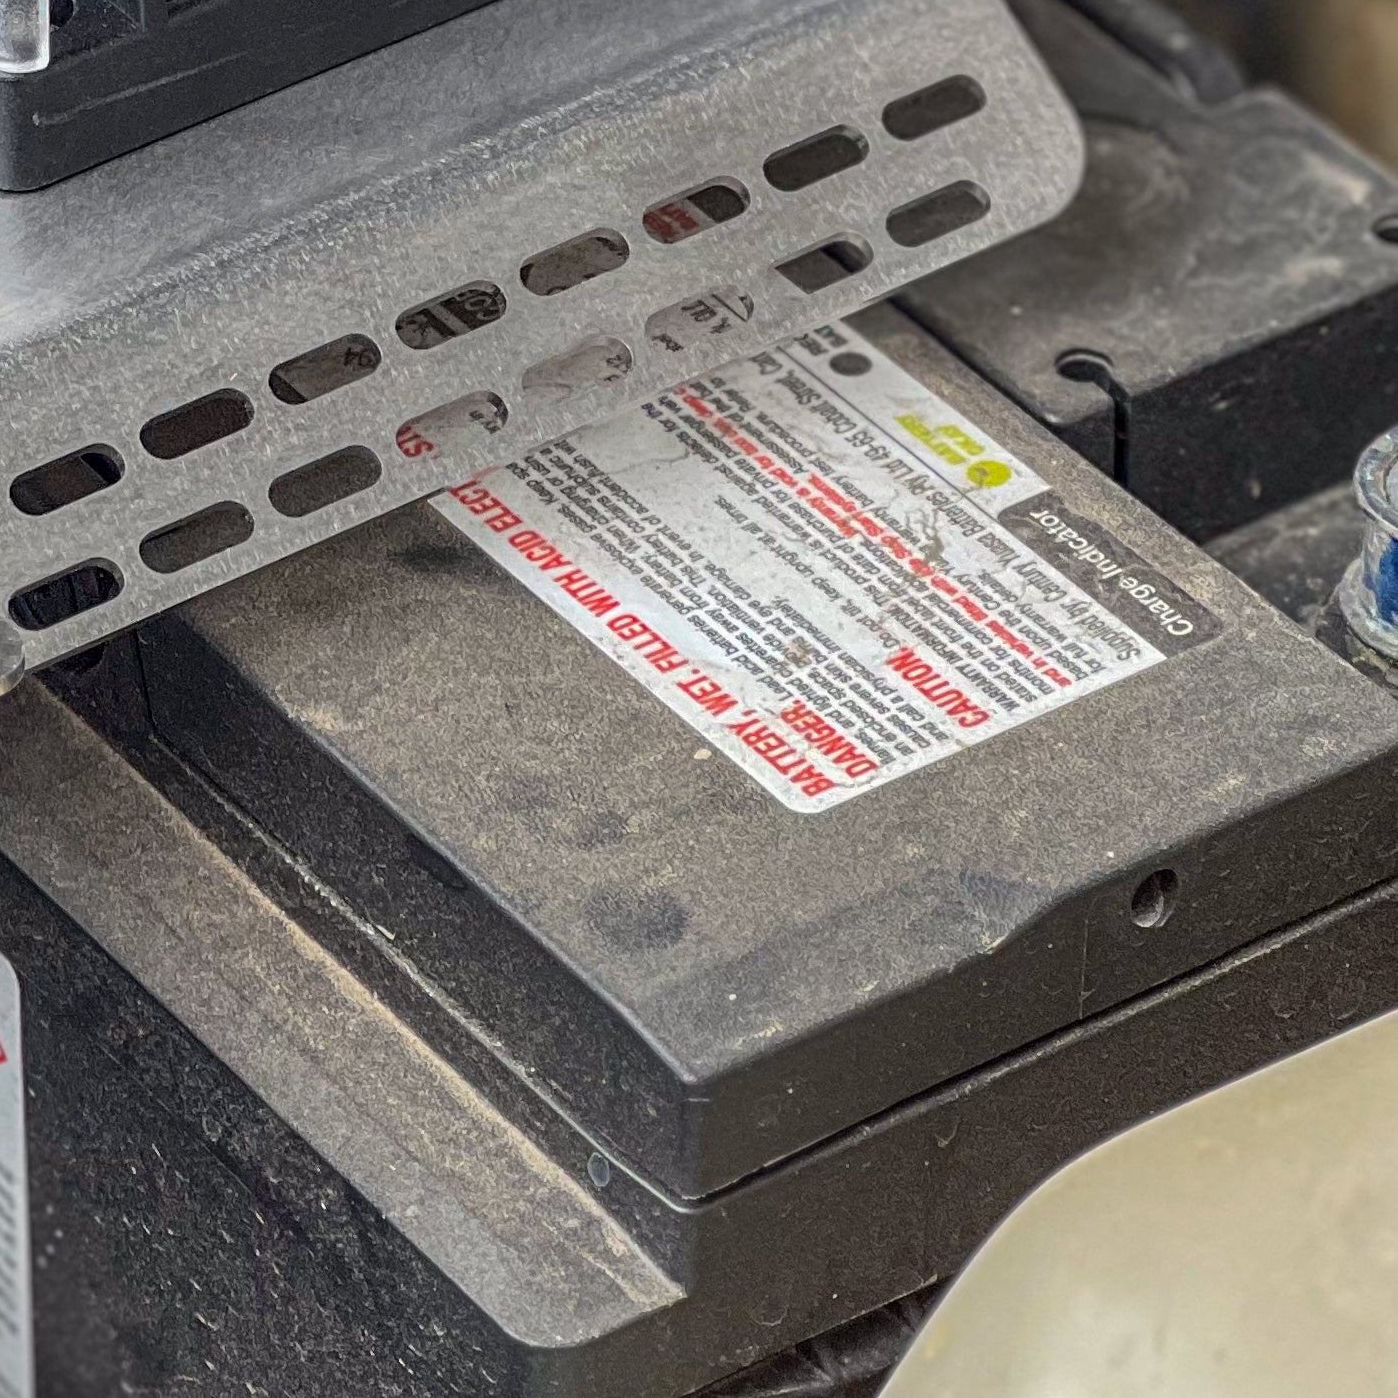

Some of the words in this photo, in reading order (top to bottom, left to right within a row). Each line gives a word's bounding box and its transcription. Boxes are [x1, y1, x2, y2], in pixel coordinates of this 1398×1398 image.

[709, 375, 728, 389] to
[772, 368, 822, 406] Street,
[640, 401, 664, 419] the
[709, 395, 734, 414] the
[722, 386, 757, 413] Refer
[658, 416, 681, 433] for
[807, 400, 858, 435] Cobalt
[675, 429, 721, 466] defects
[679, 412, 742, 458] passenger
[740, 422, 809, 475] Assessment
[844, 429, 894, 463] 49-65
[544, 474, 564, 488] or
[546, 455, 601, 497] sulphuric
[711, 462, 760, 497] against
[733, 456, 779, 488] private
[767, 466, 801, 488] void
[805, 456, 837, 477] test
[880, 459, 914, 480] Ltd
[525, 476, 560, 505] Keep
[558, 485, 610, 526] charging
[594, 475, 650, 515] accident
[770, 486, 793, 503] for
[831, 473, 875, 508] battery
[595, 495, 646, 534] contains
[640, 513, 663, 526] of
[713, 493, 750, 524] times.
[751, 495, 813, 540] warranted
[786, 500, 846, 543] purchase
[806, 494, 861, 538] Warranty
[869, 504, 923, 545] warranty
[924, 490, 985, 537] Batteries
[604, 524, 642, 553] When
[653, 524, 694, 552] event
[740, 521, 764, 535] all
[754, 532, 777, 545] at
[1029, 505, 1124, 579] Indicator
[505, 528, 571, 574] ACID
[589, 532, 646, 575] explosive
[639, 530, 685, 567] battery
[767, 543, 816, 577] upright
[808, 538, 826, 551] is
[833, 541, 857, 554] of
[975, 531, 1022, 566] Yuasa
[678, 564, 708, 587] This
[816, 548, 871, 585] product
[850, 552, 882, 576] date
[552, 568, 622, 616] WITH
[639, 573, 696, 615] generate
[810, 574, 844, 601] keep
[862, 583, 892, 606] This
[926, 574, 960, 596] with
[953, 571, 1003, 611] Century
[976, 567, 1021, 604] details.
[1012, 559, 1068, 603] Century
[678, 585, 711, 610] from
[746, 598, 775, 618] eye
[899, 595, 937, 621] label
[1116, 575, 1196, 637] Charge
[704, 606, 740, 633] away
[765, 616, 796, 636] and
[770, 594, 842, 655] immediately.
[854, 614, 883, 632] not
[921, 591, 995, 645] commercial
[927, 617, 964, 643] front
[997, 608, 1022, 627] the
[1014, 600, 1070, 643] warranty
[604, 612, 690, 673] FILLED
[687, 613, 741, 656] batteries
[877, 631, 901, 648] Do
[958, 641, 984, 660] the
[1017, 624, 1053, 650] upon
[1060, 641, 1089, 660] full
[1074, 614, 1140, 661] Supplied
[730, 653, 765, 675] acid
[733, 631, 795, 678] cigarettes
[979, 657, 1001, 672] on
[988, 643, 1012, 661] for
[1030, 656, 1049, 670] in
[1044, 649, 1089, 681] based
[1083, 657, 1107, 674] for
[756, 674, 794, 701] Lead
[806, 666, 847, 700] space,
[823, 661, 854, 683] skin
[836, 651, 897, 696] physician
[885, 645, 992, 729] CAUTION.
[954, 661, 1021, 711] WARRANTY
[992, 670, 1038, 702] stated
[1006, 658, 1056, 695] months
[1040, 667, 1073, 688] and
[676, 666, 739, 715] WET.
[785, 676, 833, 712] lighted
[847, 681, 891, 714] severe
[889, 695, 904, 704] a
[824, 709, 856, 729] and
[838, 699, 899, 743] enclosed
[895, 702, 926, 722] call
[778, 698, 877, 777] DANGER.
[885, 713, 932, 748] causes
[917, 721, 949, 741] and
[726, 707, 837, 796] BATTERY,
[892, 741, 915, 756] an
